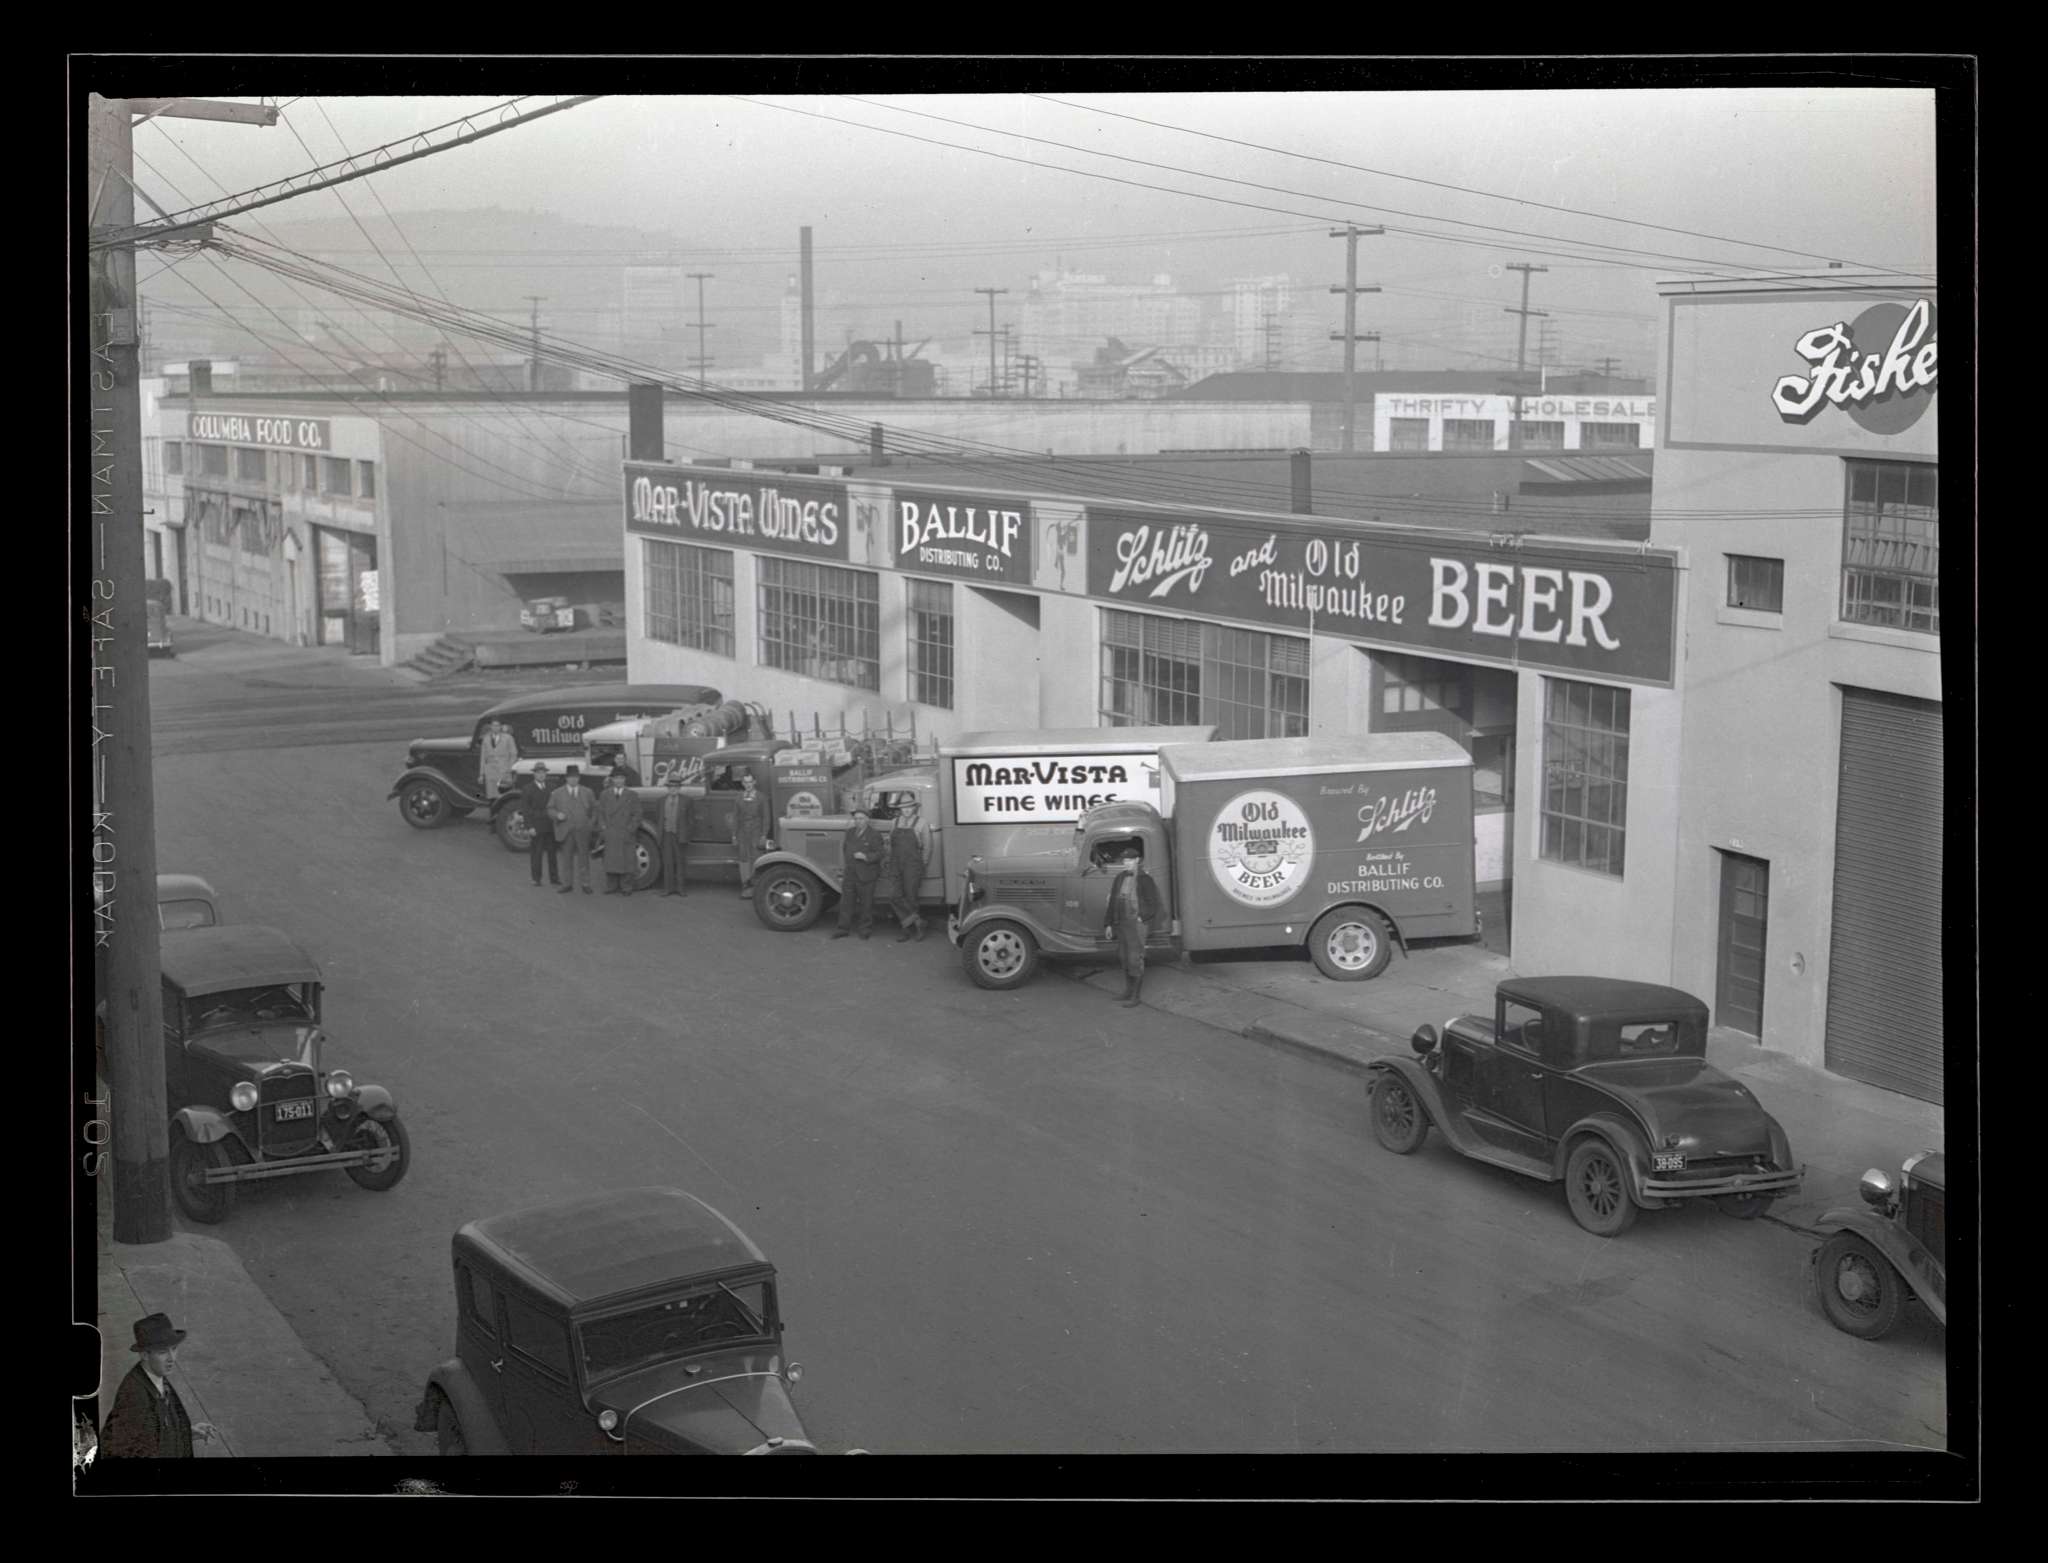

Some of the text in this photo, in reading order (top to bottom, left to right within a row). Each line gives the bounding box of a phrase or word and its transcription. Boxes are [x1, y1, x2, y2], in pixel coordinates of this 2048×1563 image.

[1389, 398, 1487, 414] THRIFTY
[192, 415, 252, 442] COLUMBIA
[256, 418, 293, 444] FOOD
[759, 487, 840, 546] WINES
[900, 501, 1022, 559] BALLIF
[919, 546, 1005, 572] DISTRIBUTING CO.
[1108, 523, 1621, 651] Schlitz and Old BEER
[1258, 568, 1406, 625] Milwaukee
[558, 714, 585, 729] Old
[983, 795, 1036, 813] FINE
[1241, 800, 1280, 822] Old
[1355, 785, 1438, 844] Schlitz
[1216, 820, 1308, 843] Milwaukee
[1237, 870, 1287, 889] BEER
[1358, 861, 1413, 878] BALLIF
[1327, 875, 1446, 895] DISTRIBUTING CO.
